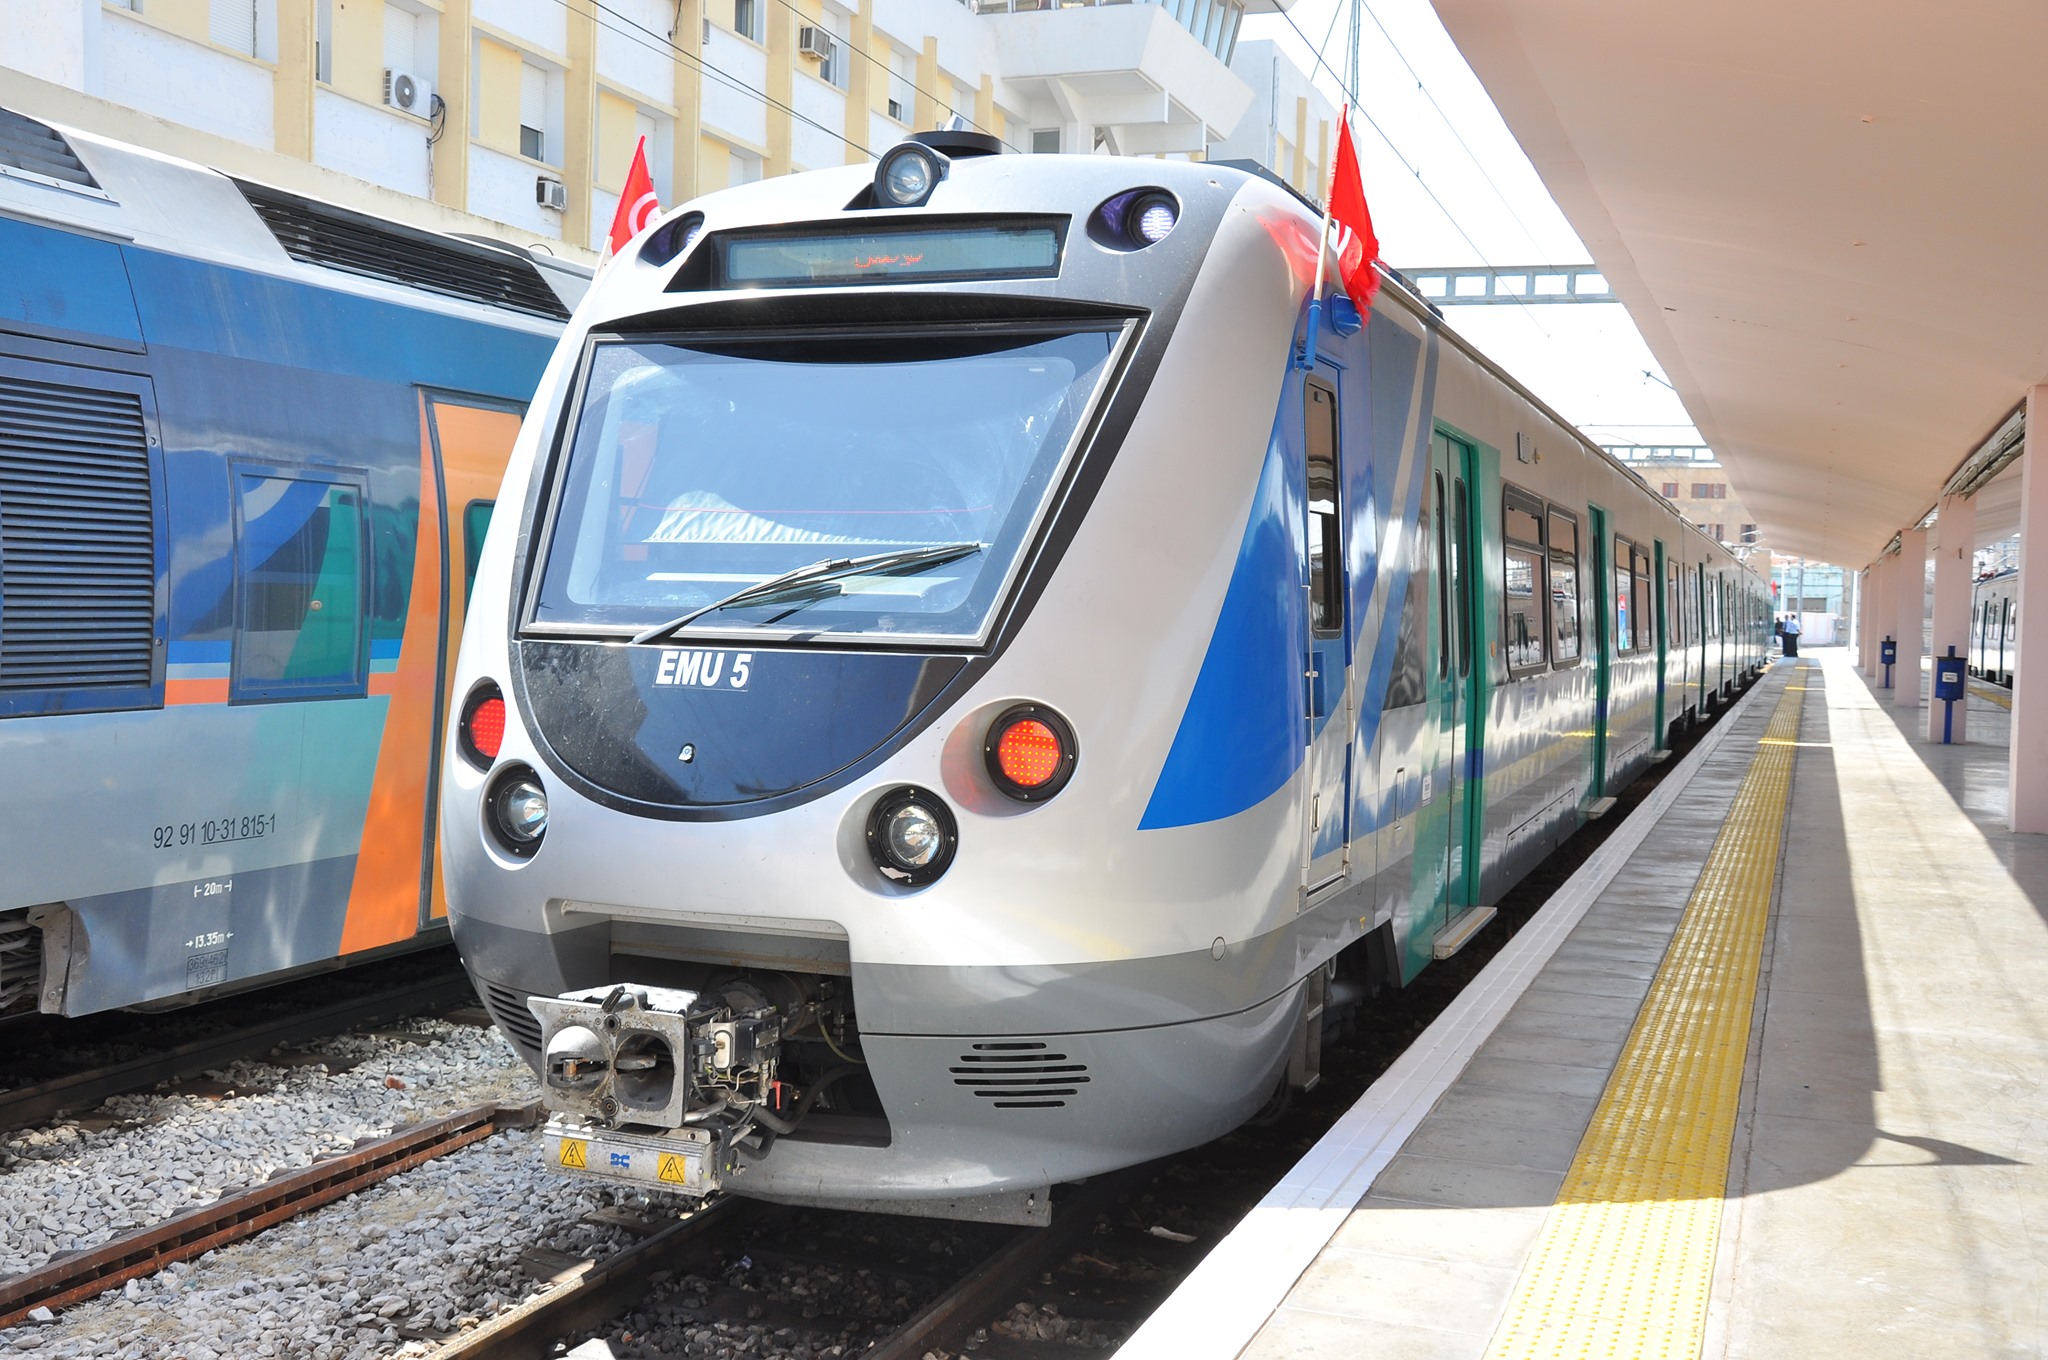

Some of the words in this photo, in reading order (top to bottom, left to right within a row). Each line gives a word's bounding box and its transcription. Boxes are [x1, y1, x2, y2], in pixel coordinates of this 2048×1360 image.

[655, 650, 725, 687] EMU
[729, 653, 752, 689] 5
[153, 826, 174, 849] 92
[179, 822, 196, 845] 91
[201, 818, 236, 843] 10-31
[240, 813, 276, 838] 815-1
[203, 881, 223, 897] 20m
[195, 931, 225, 949] 13.35m
